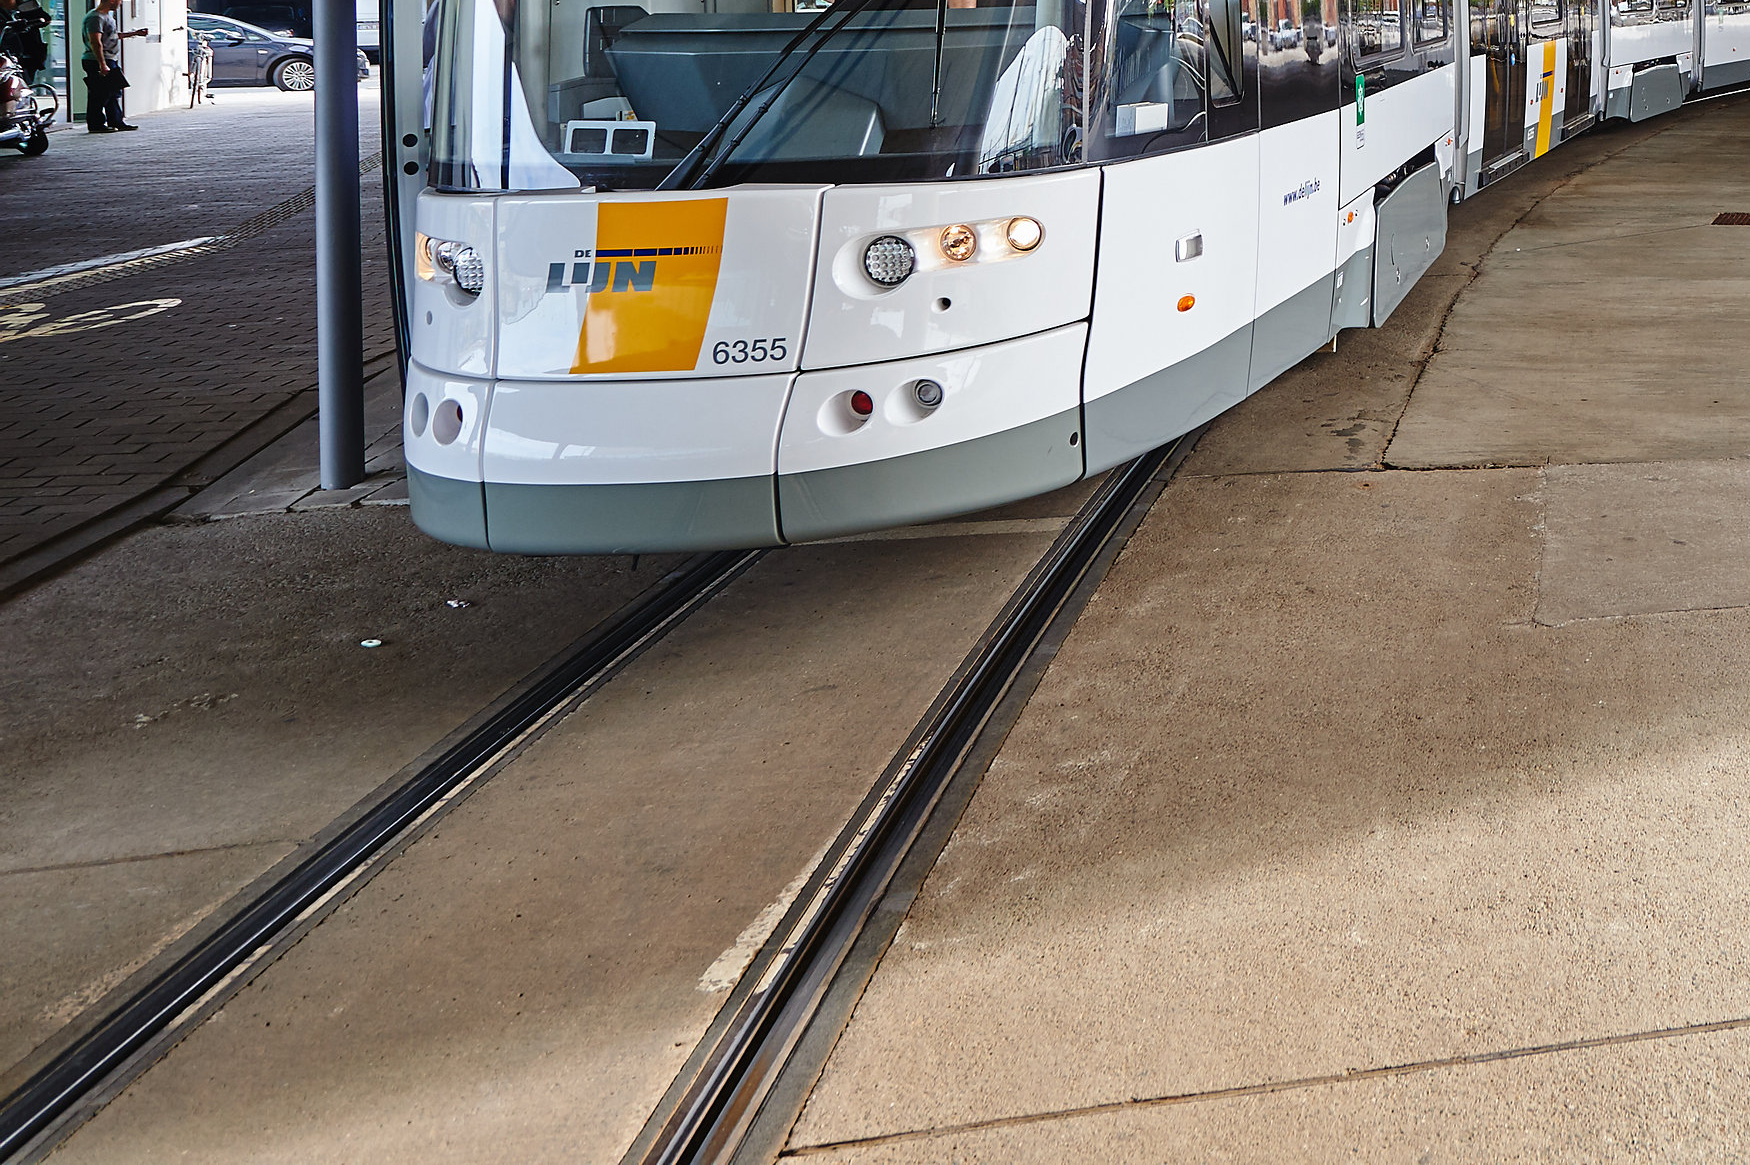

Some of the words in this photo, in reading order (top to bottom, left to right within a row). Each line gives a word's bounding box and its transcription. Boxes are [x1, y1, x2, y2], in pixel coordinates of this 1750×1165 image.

[1283, 176, 1321, 206] www.delijn.be
[574, 248, 592, 258] DE
[546, 260, 657, 294] LIJN
[712, 337, 788, 364] 6355
